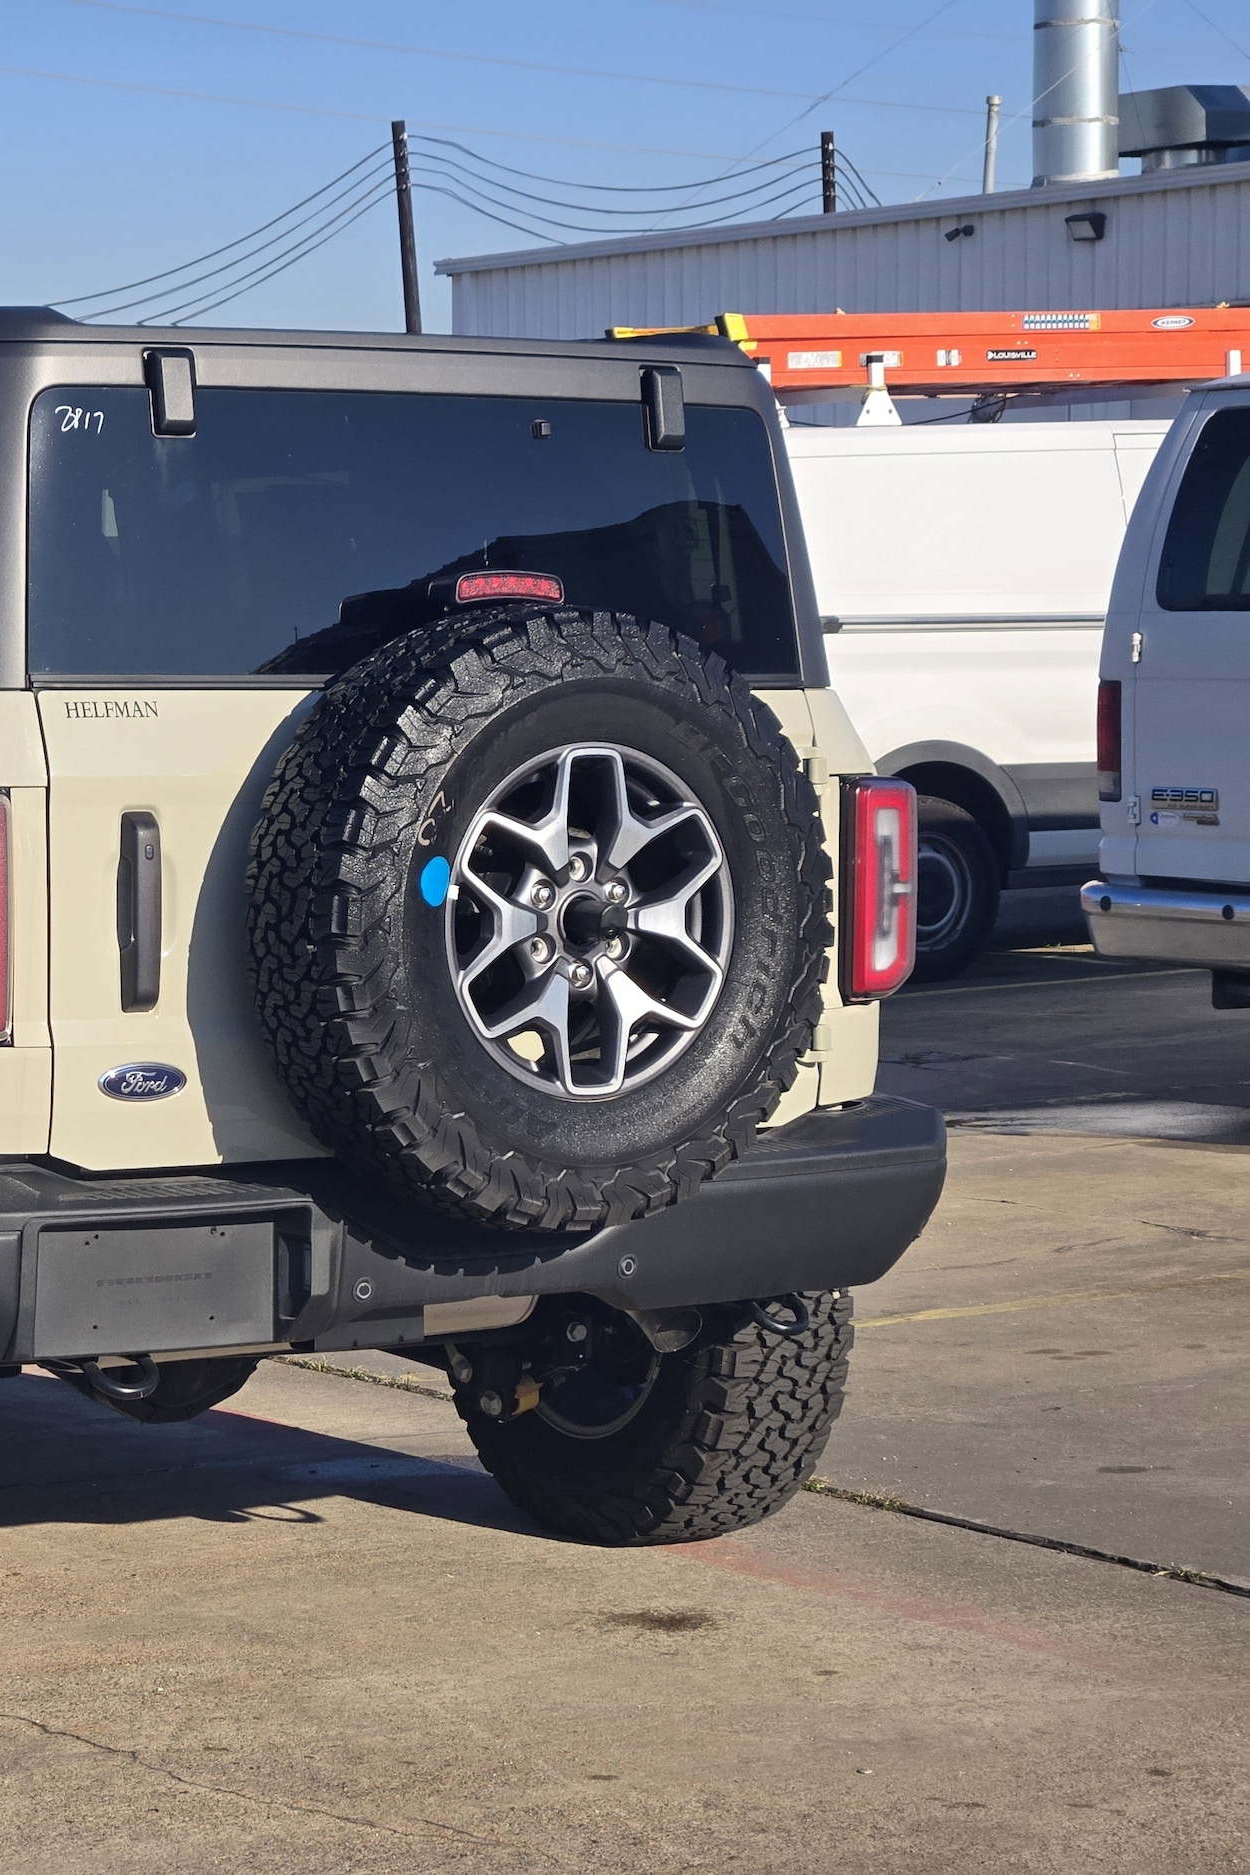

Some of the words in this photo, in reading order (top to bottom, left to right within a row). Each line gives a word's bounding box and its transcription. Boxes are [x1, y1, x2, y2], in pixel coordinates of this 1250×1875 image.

[993, 351, 1037, 359] LOUISVILLE
[63, 700, 159, 719] HELFMAN
[120, 1070, 168, 1095] Ford
